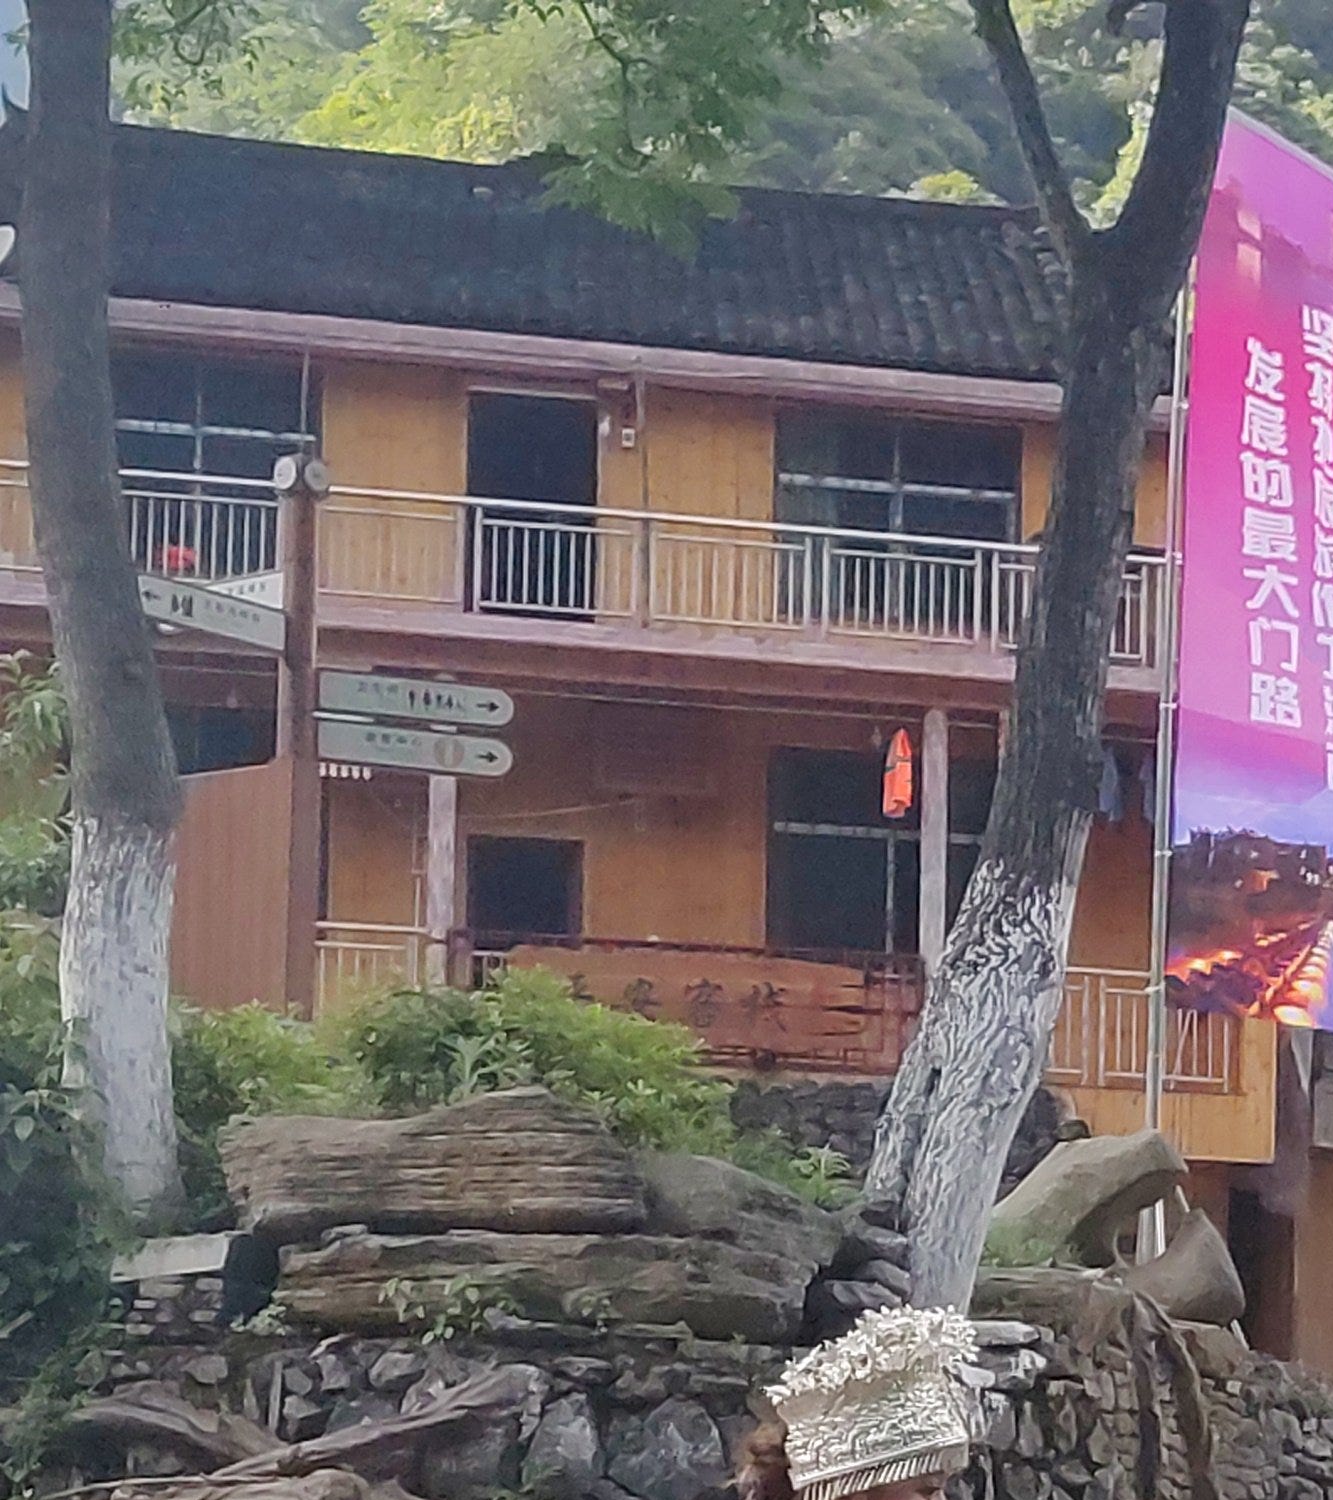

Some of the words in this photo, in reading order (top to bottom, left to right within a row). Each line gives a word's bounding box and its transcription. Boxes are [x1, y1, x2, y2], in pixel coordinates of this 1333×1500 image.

[1240, 335, 1303, 728] 发展的最大门路
